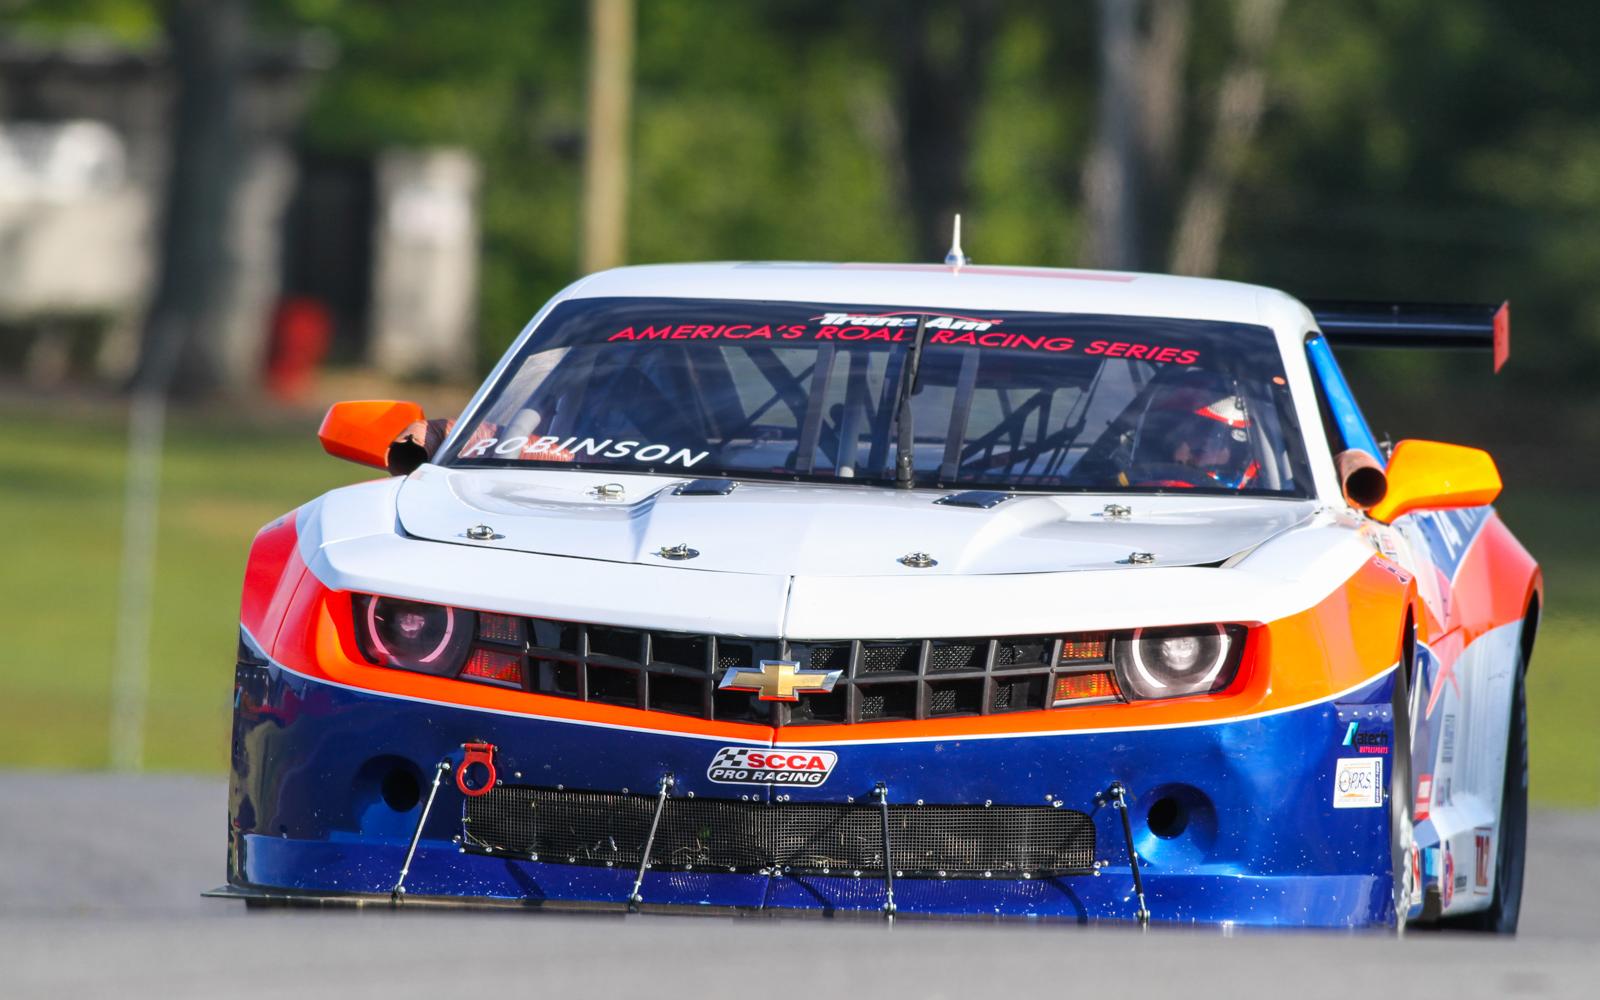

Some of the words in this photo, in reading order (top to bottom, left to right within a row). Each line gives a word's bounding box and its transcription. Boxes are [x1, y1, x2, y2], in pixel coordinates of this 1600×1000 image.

[820, 312, 918, 327] Trans
[924, 316, 992, 331] Am
[607, 324, 807, 341] AMERICA'S
[930, 329, 1076, 352] RACING
[1084, 340, 1201, 365] SERIES
[463, 435, 710, 468] ROBINSON
[747, 753, 827, 771] SCCA
[712, 768, 748, 781] PRO
[752, 771, 823, 783] RACING
